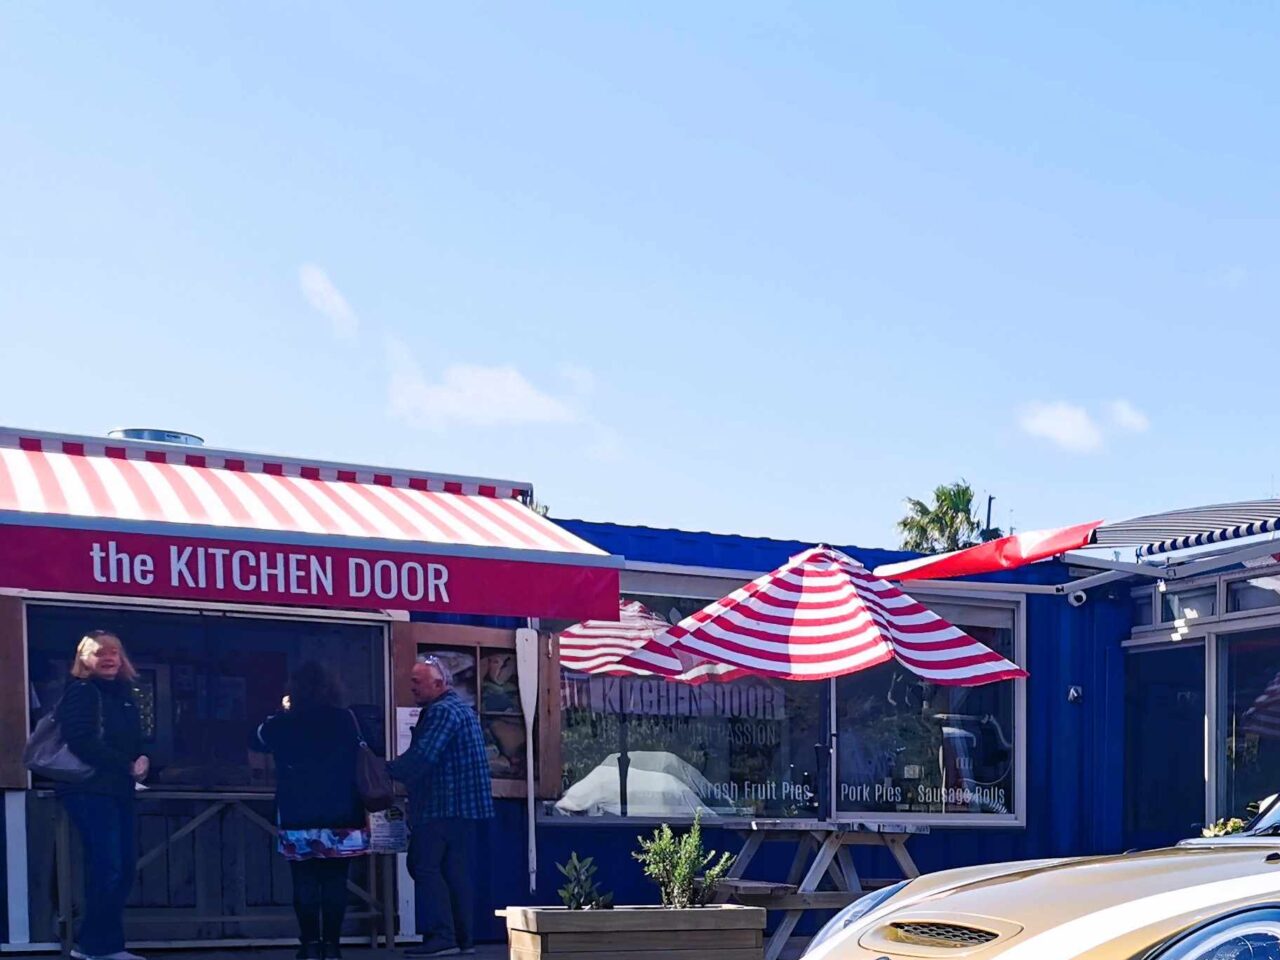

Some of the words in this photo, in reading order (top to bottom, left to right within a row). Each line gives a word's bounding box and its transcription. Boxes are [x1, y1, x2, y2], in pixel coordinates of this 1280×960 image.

[90, 541, 154, 583] the
[169, 545, 334, 596] KITCHEN
[348, 557, 450, 603] DOOR
[712, 683, 776, 719] DOOR
[718, 722, 776, 745] PASSION
[744, 780, 777, 800] Fruit
[782, 781, 811, 800] Pies
[840, 783, 871, 802] Pork
[875, 783, 902, 802] Pies
[917, 784, 971, 805] Sausage
[974, 785, 1006, 804] Rolls
